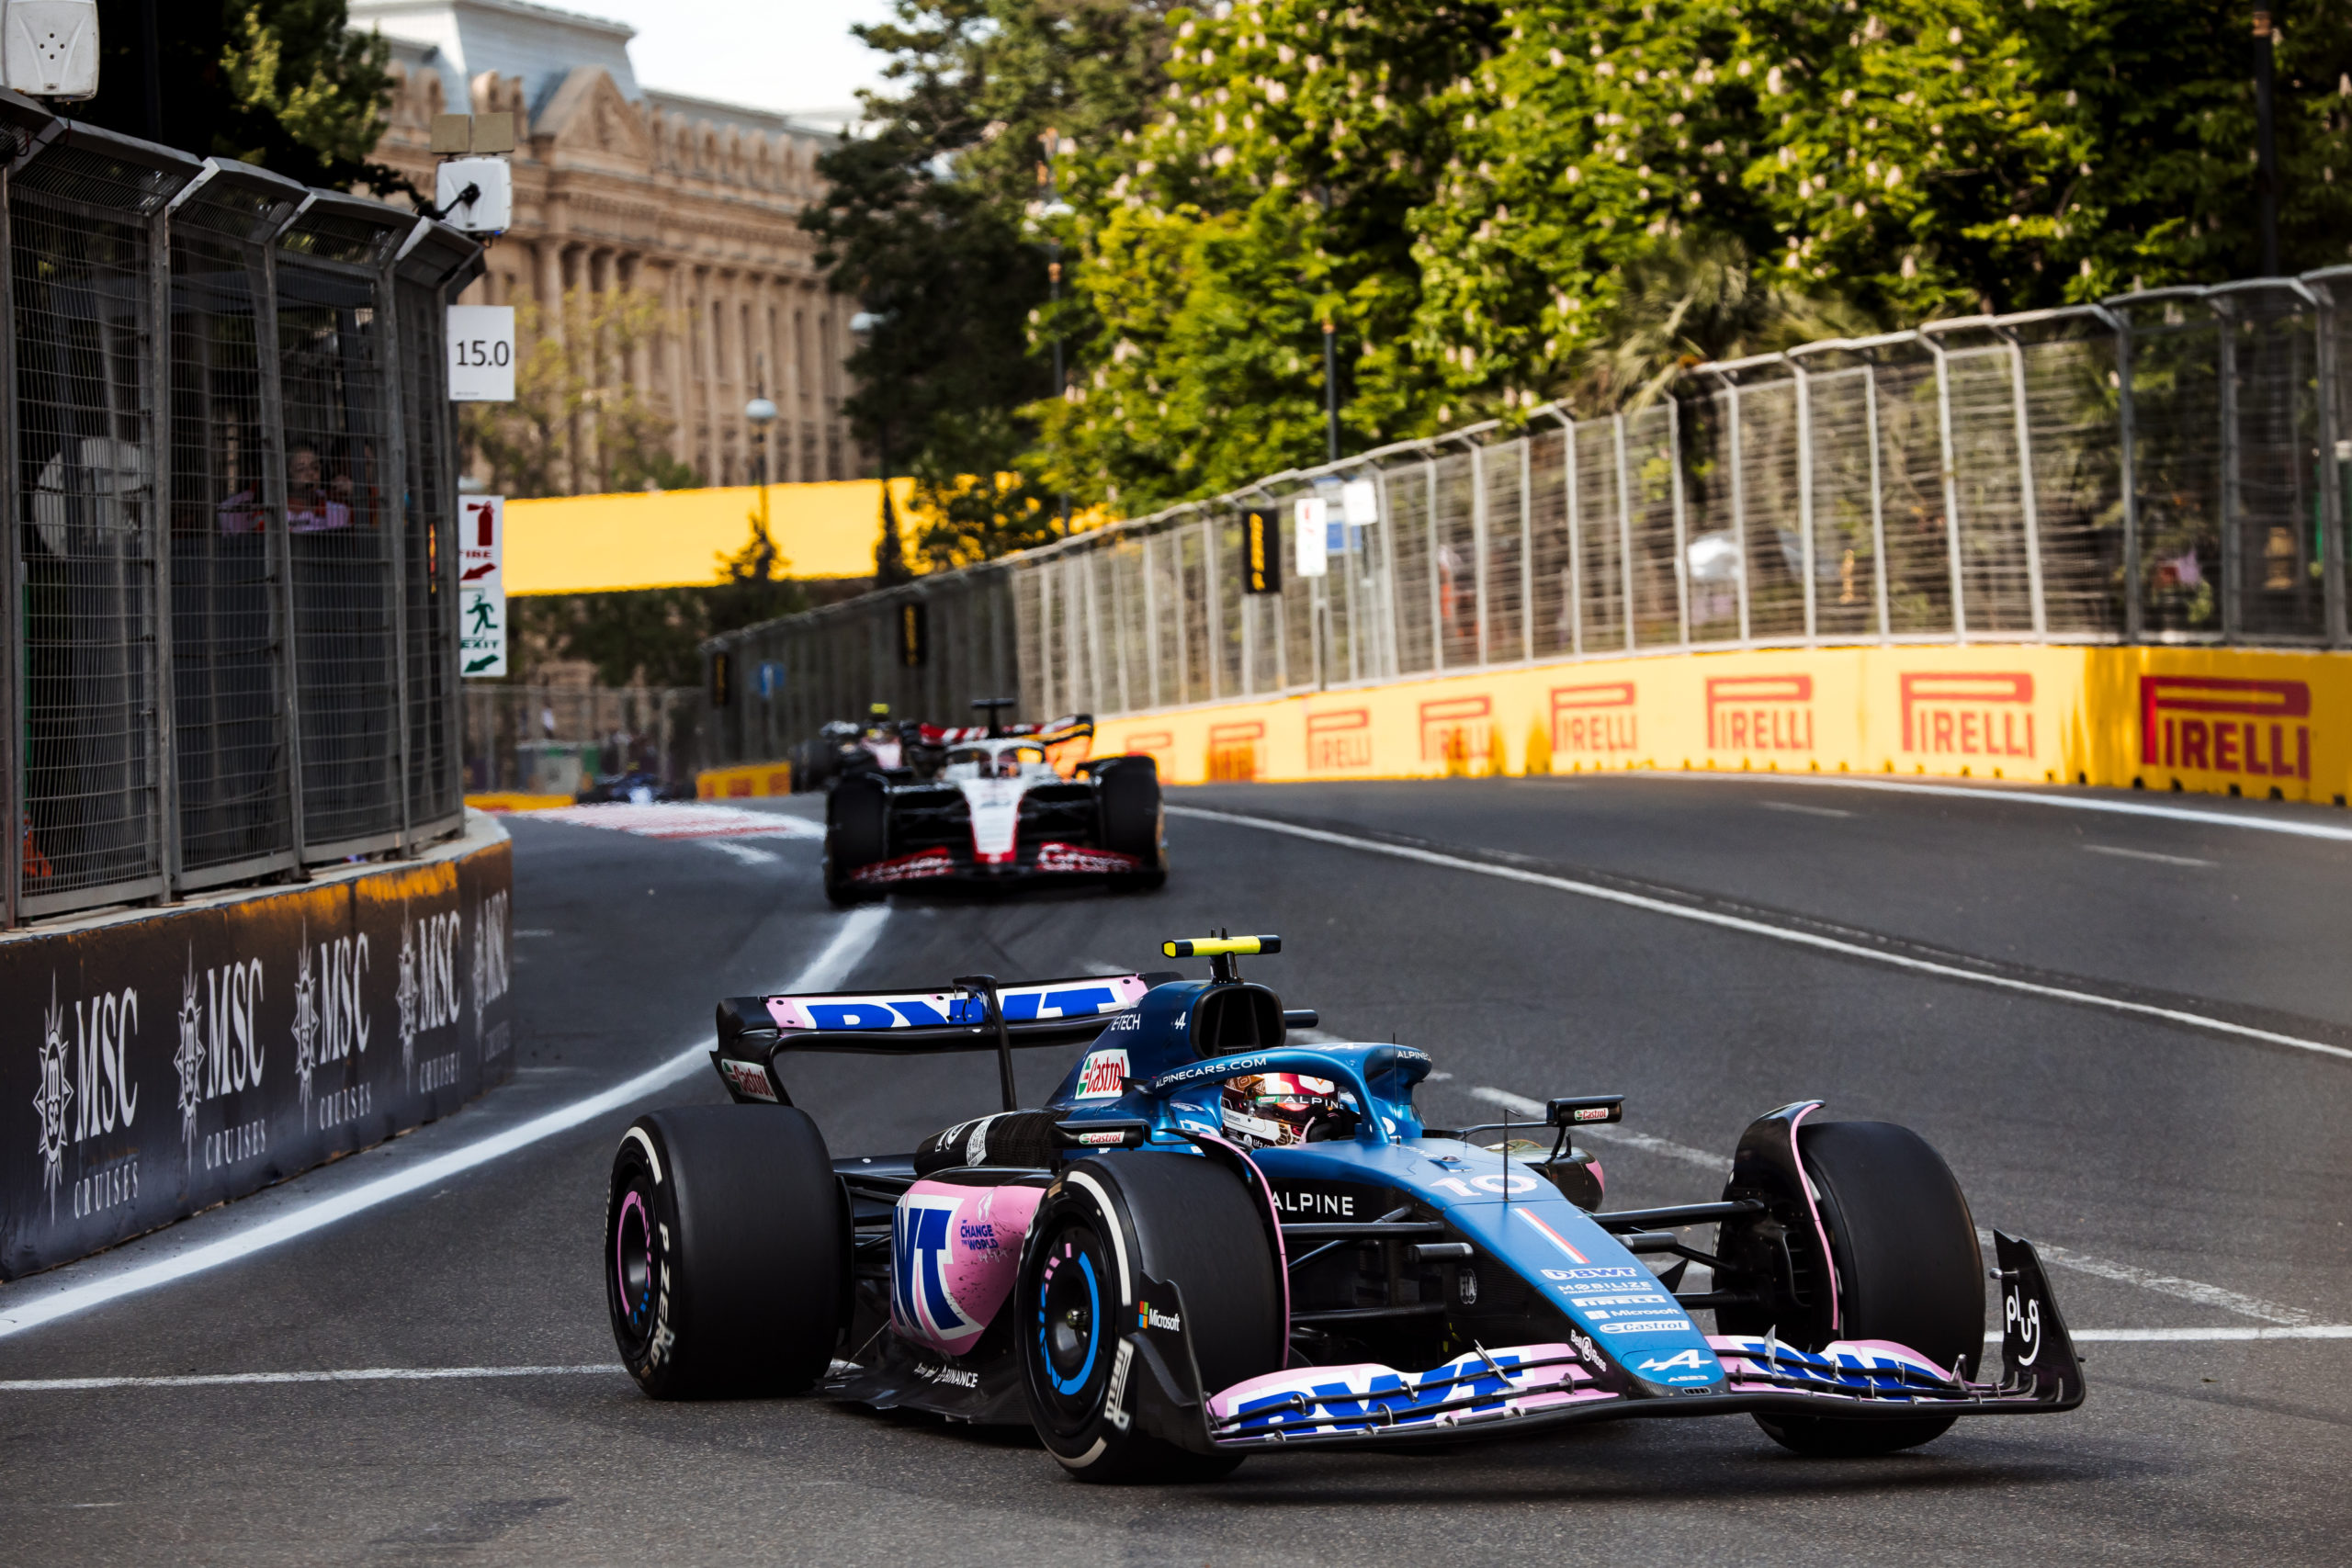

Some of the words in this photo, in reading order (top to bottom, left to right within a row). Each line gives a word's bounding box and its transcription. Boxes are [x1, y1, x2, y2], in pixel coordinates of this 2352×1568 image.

[457, 341, 510, 367] 15.0
[460, 639, 500, 649] EXIT
[1419, 694, 1494, 762] PIRELLI
[1551, 682, 1637, 752] PIRELLI
[1706, 674, 1814, 750] PIRELLI
[1899, 672, 2035, 759] PIRELLI
[2141, 675, 2312, 781] PIRELLI
[419, 909, 460, 1032] MSC
[320, 932, 370, 1065] MSC
[207, 957, 265, 1100] MSC
[1110, 1013, 1141, 1032] E-TECH
[74, 987, 138, 1143] MSC
[733, 1065, 775, 1097] Castrol
[1086, 1055, 1125, 1094] Castrol
[1155, 1057, 1267, 1089] ALPINECARS.COM
[319, 1081, 371, 1131] CRUISES
[1582, 1109, 1608, 1121] Castrol
[205, 1119, 266, 1170] CRUISES
[1090, 1133, 1122, 1144] Castrol
[74, 1161, 139, 1220] CRUISES
[1430, 1174, 1539, 1197] 10
[1272, 1191, 1355, 1217] ALPINE
[960, 1224, 994, 1238] CHANGE
[967, 1238, 999, 1250] WORLD
[1574, 1268, 1636, 1278] BWT
[1148, 1309, 1181, 1332] Microsoft
[1610, 1308, 1681, 1317] Microsoft
[1623, 1320, 1685, 1331] Castrol
[2007, 1285, 2041, 1367] plug
[1571, 1329, 1583, 1349] Bell
[1592, 1348, 1607, 1372] Ross
[942, 1369, 978, 1388] BINANCE
[1104, 1337, 1134, 1430] PIRELLI
